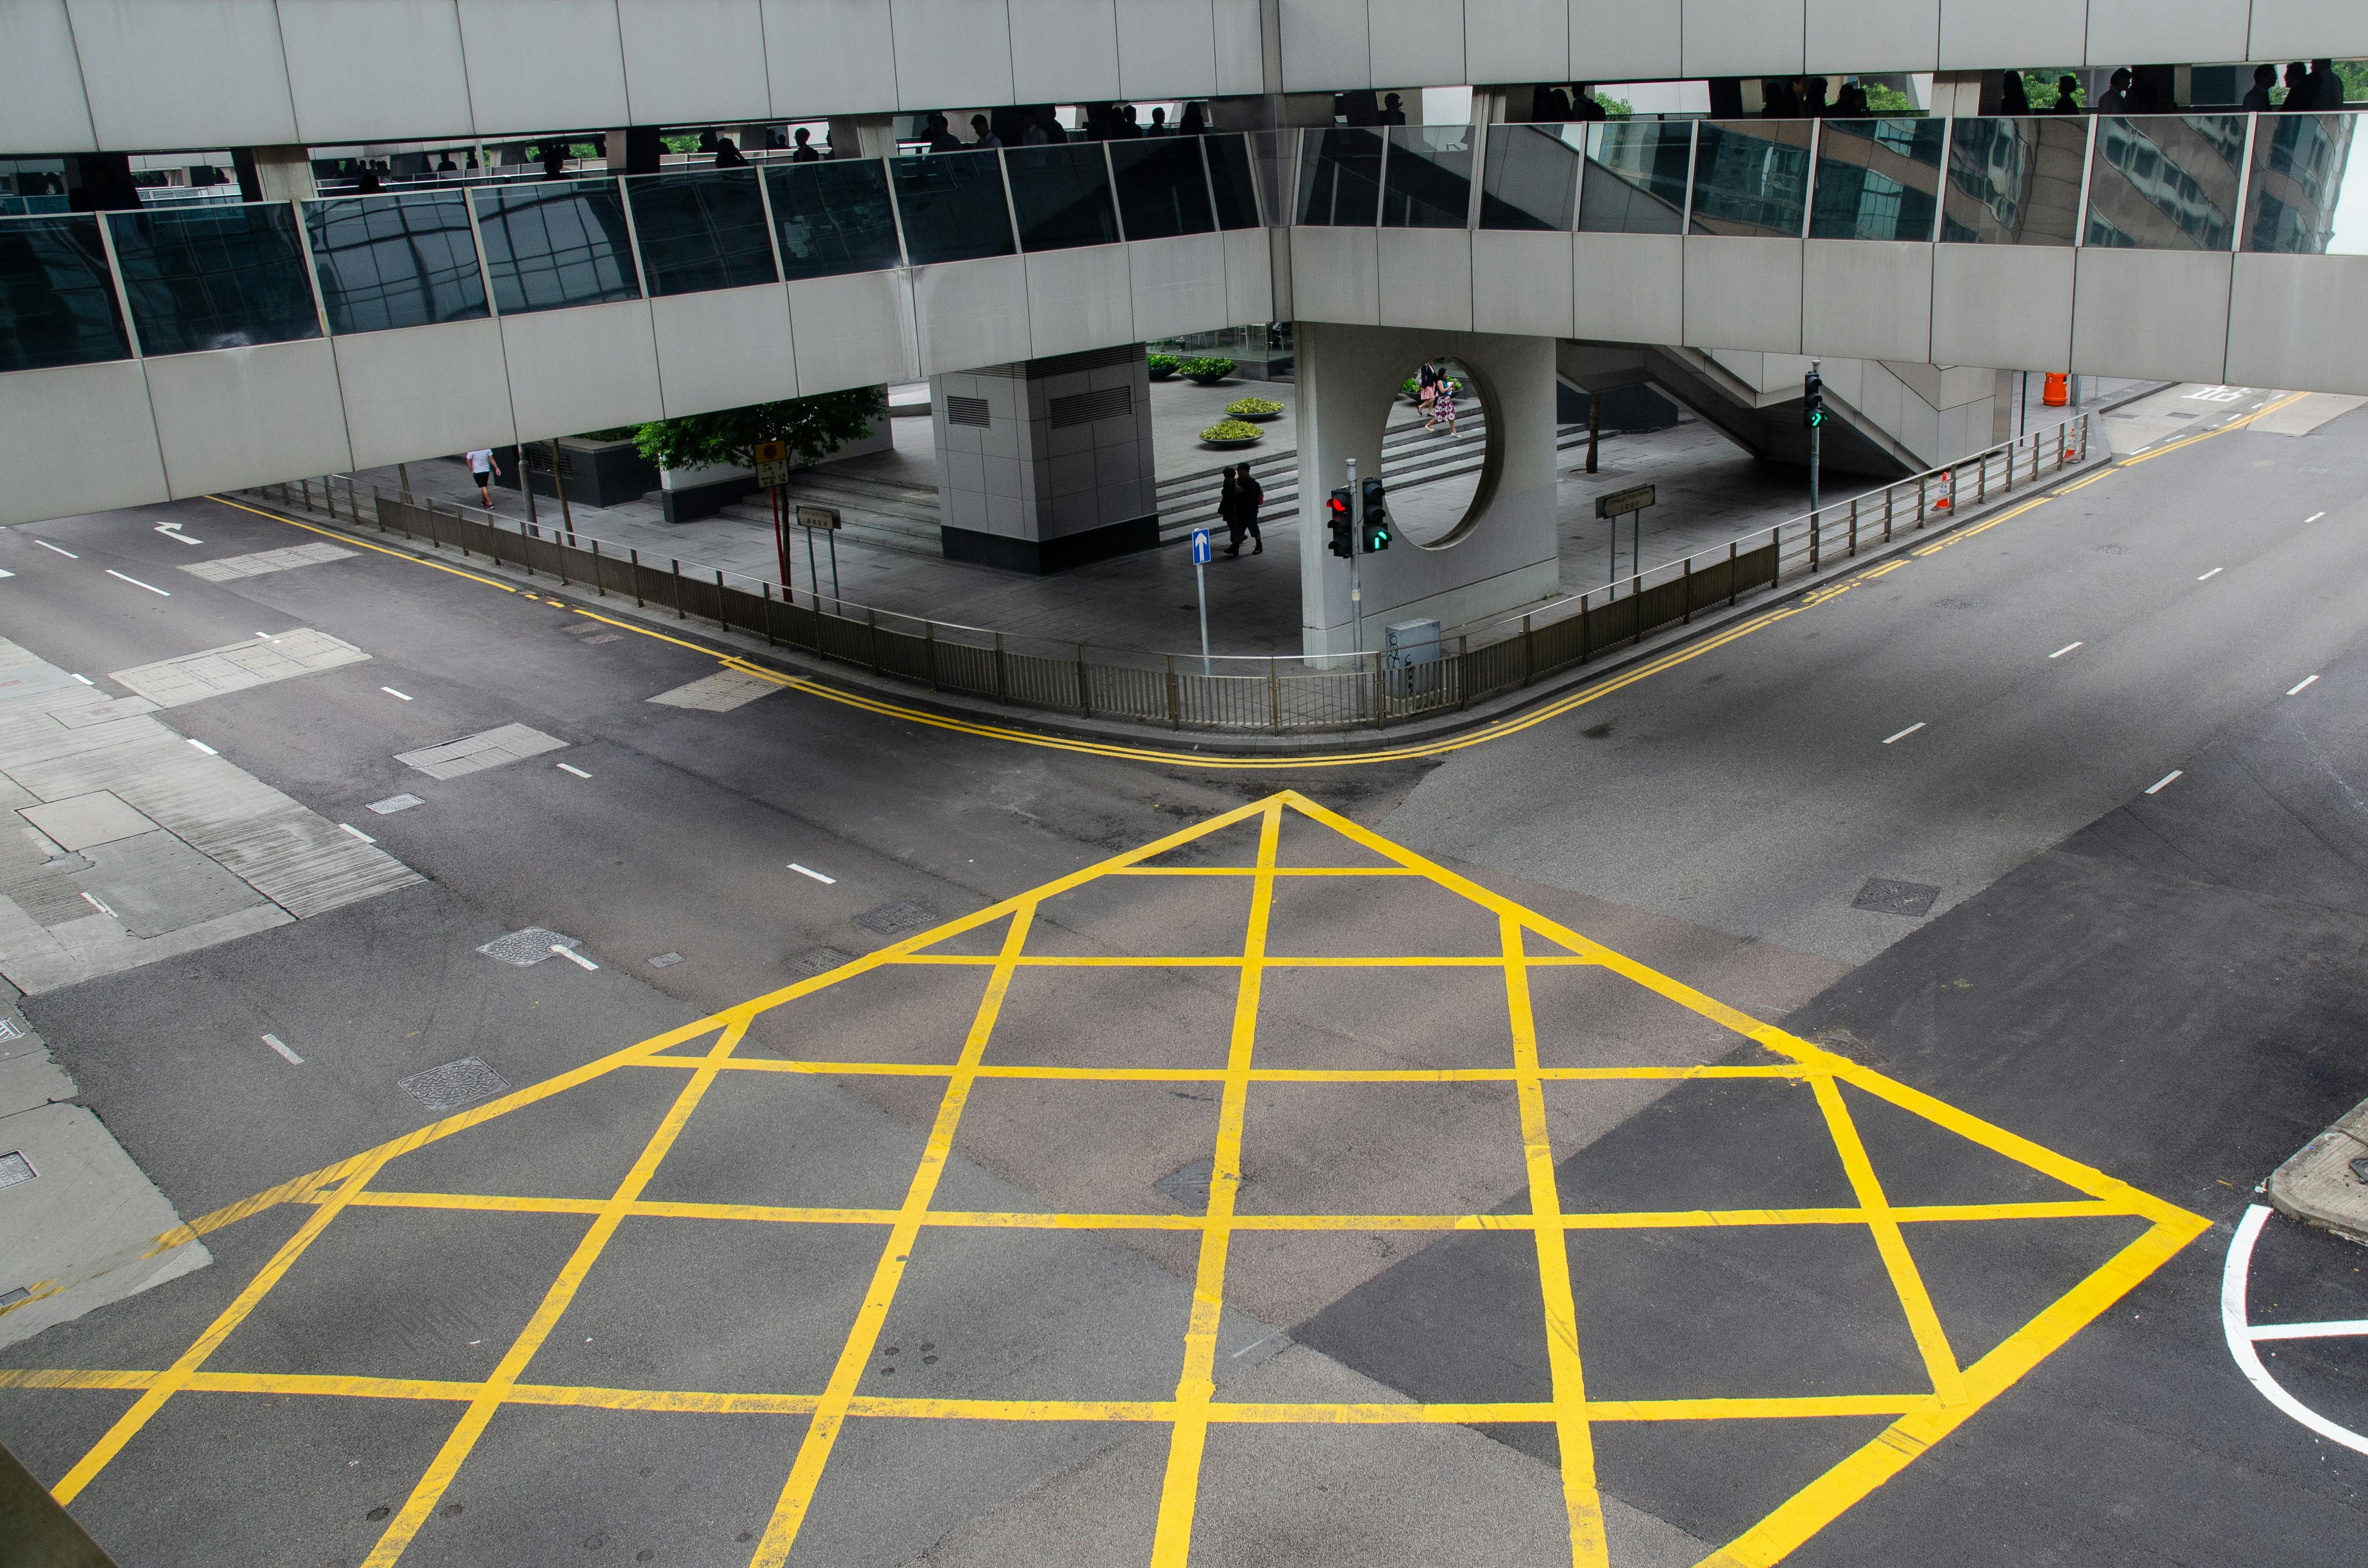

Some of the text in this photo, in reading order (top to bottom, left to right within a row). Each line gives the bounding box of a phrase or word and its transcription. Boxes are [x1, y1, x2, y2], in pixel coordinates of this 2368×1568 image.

[2180, 383, 2252, 402] 站
[778, 461, 783, 470] 7
[778, 474, 786, 482] 12
